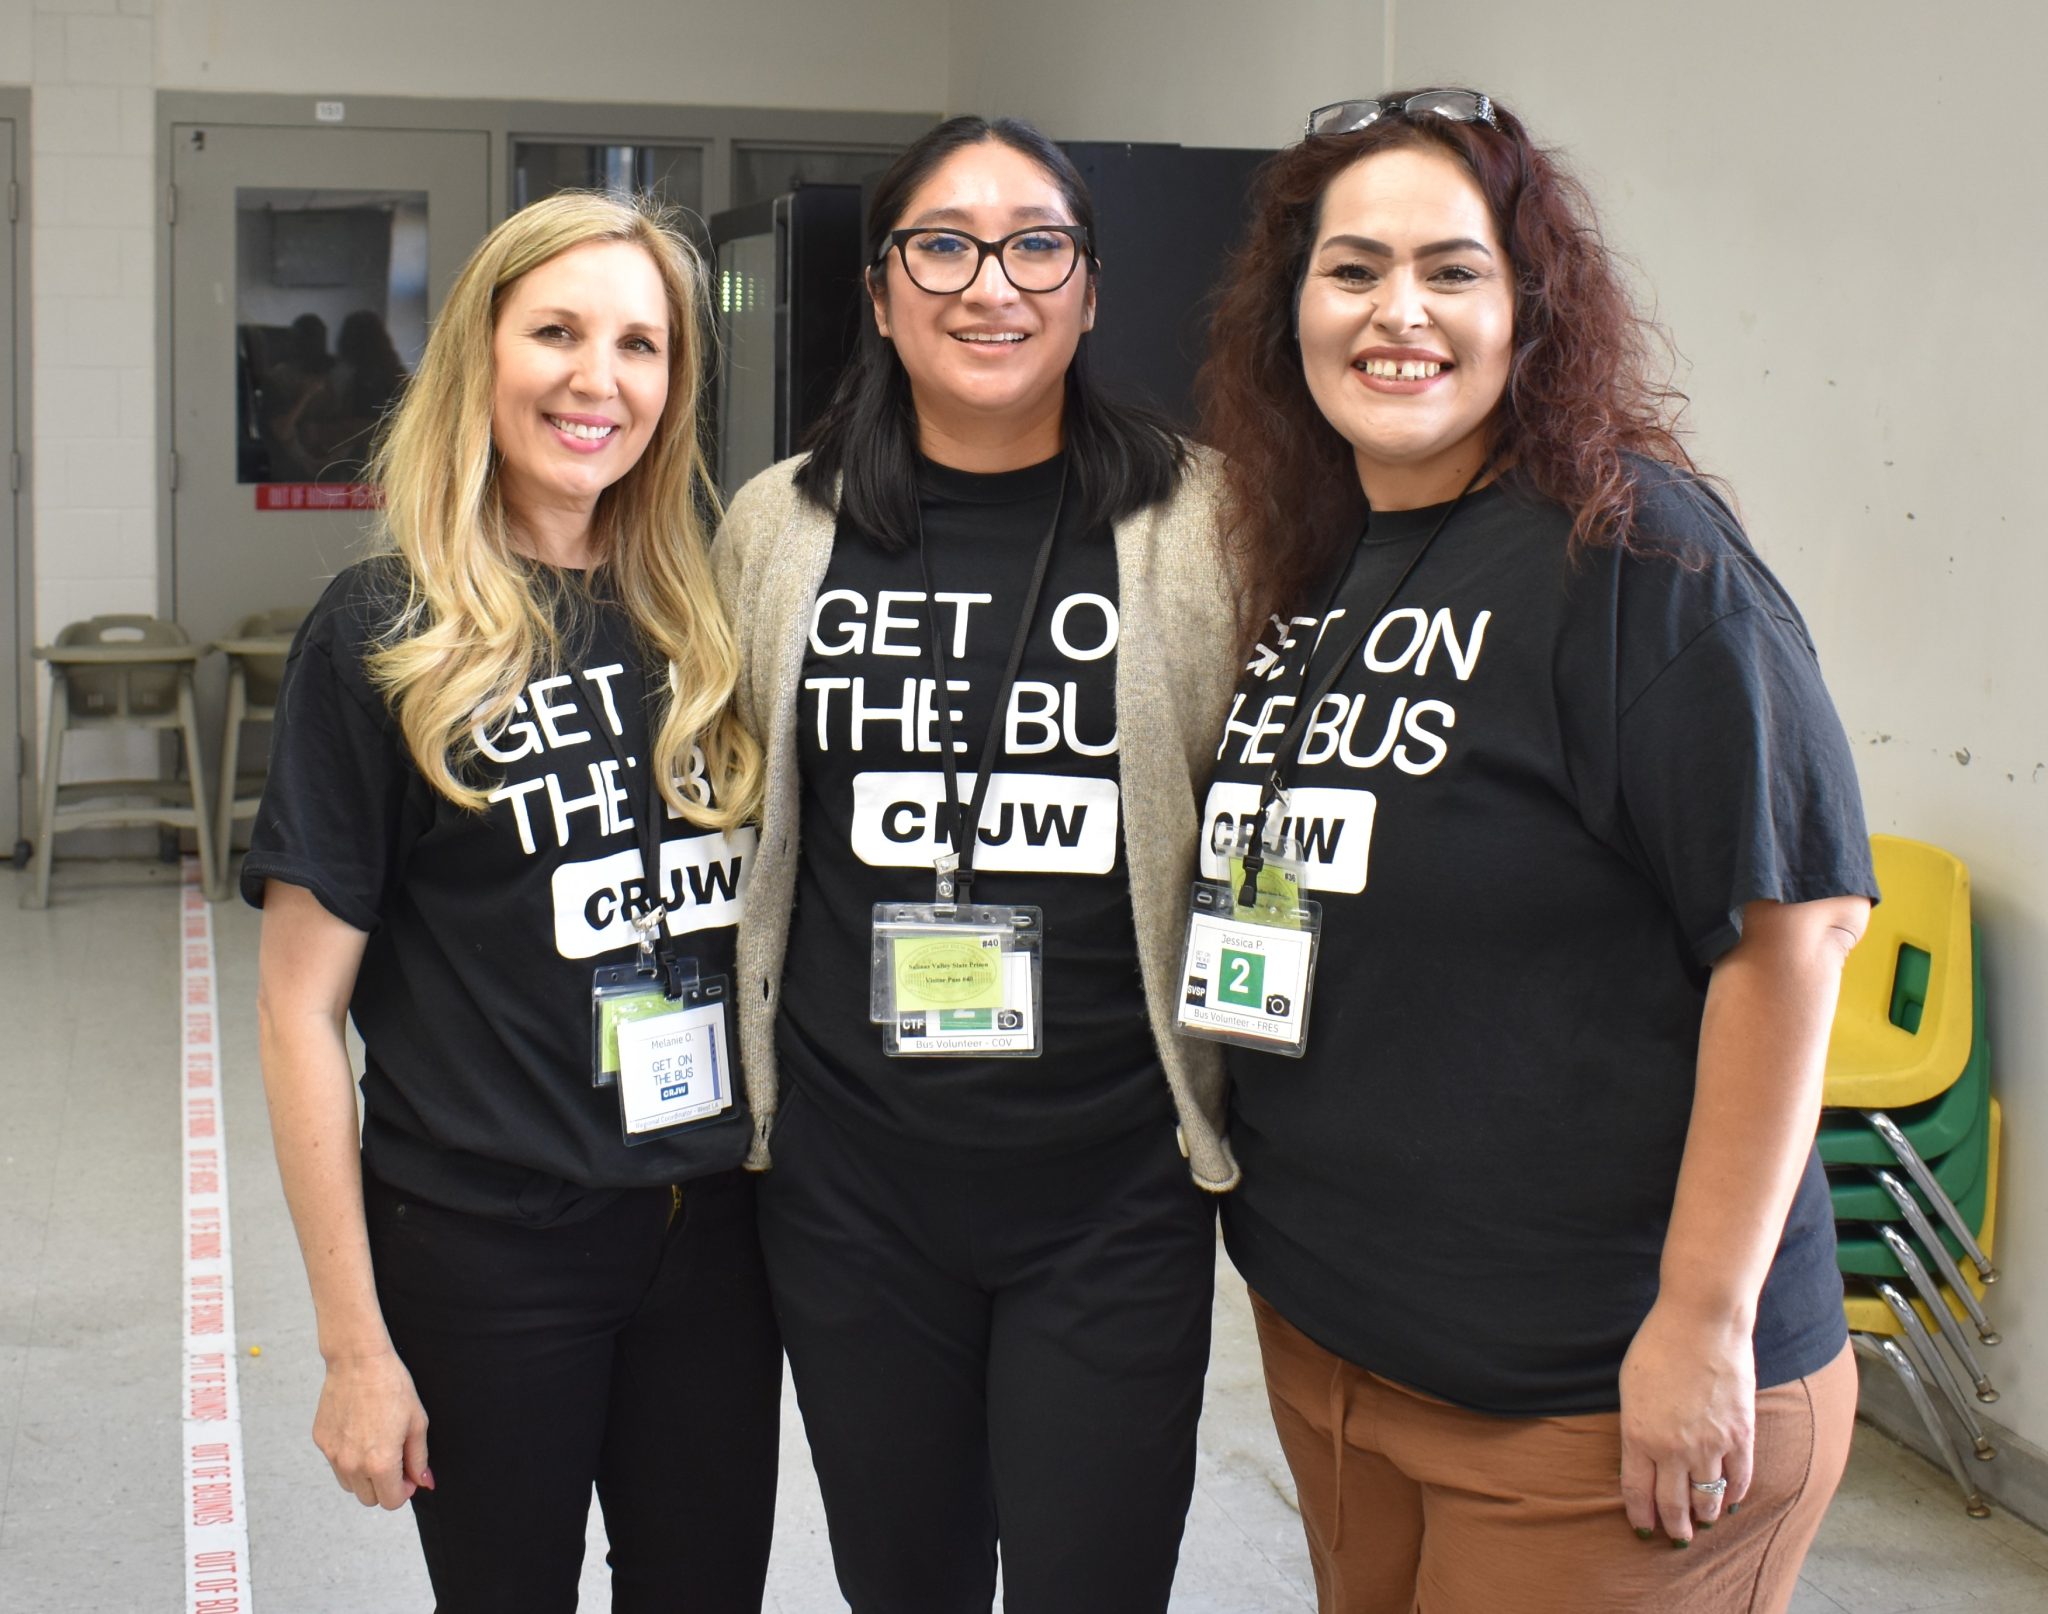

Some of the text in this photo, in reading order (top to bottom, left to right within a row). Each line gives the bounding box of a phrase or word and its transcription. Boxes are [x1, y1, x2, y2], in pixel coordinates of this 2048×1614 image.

[808, 589, 992, 658] GET
[1364, 607, 1491, 681] ON
[471, 663, 624, 763] GET
[805, 677, 970, 752] THE
[1217, 693, 1456, 776] HE BUS
[488, 756, 637, 854] THE
[584, 856, 743, 931] CRJW
[982, 938, 999, 948] #40
[1221, 934, 1265, 951] Jessica P.
[1229, 957, 1251, 994] 2
[1187, 985, 1206, 998] SVSP
[902, 1019, 925, 1030] CTF
[1194, 1008, 1209, 1019] Bus
[1210, 1012, 1250, 1027] Volunteer
[1257, 1020, 1279, 1033] FRES
[651, 1037, 684, 1049] Melanie
[916, 1040, 934, 1048] Bus
[935, 1039, 982, 1048] Volunteer
[992, 1038, 1013, 1048] COV
[652, 1053, 693, 1072] GET ON
[653, 1068, 693, 1086] THE BUS
[662, 1085, 687, 1098] CRJW
[192, 1443, 233, 1526] OUT OF BOUNDS
[194, 1551, 236, 1574] OUT
[195, 1578, 238, 1592] OF
